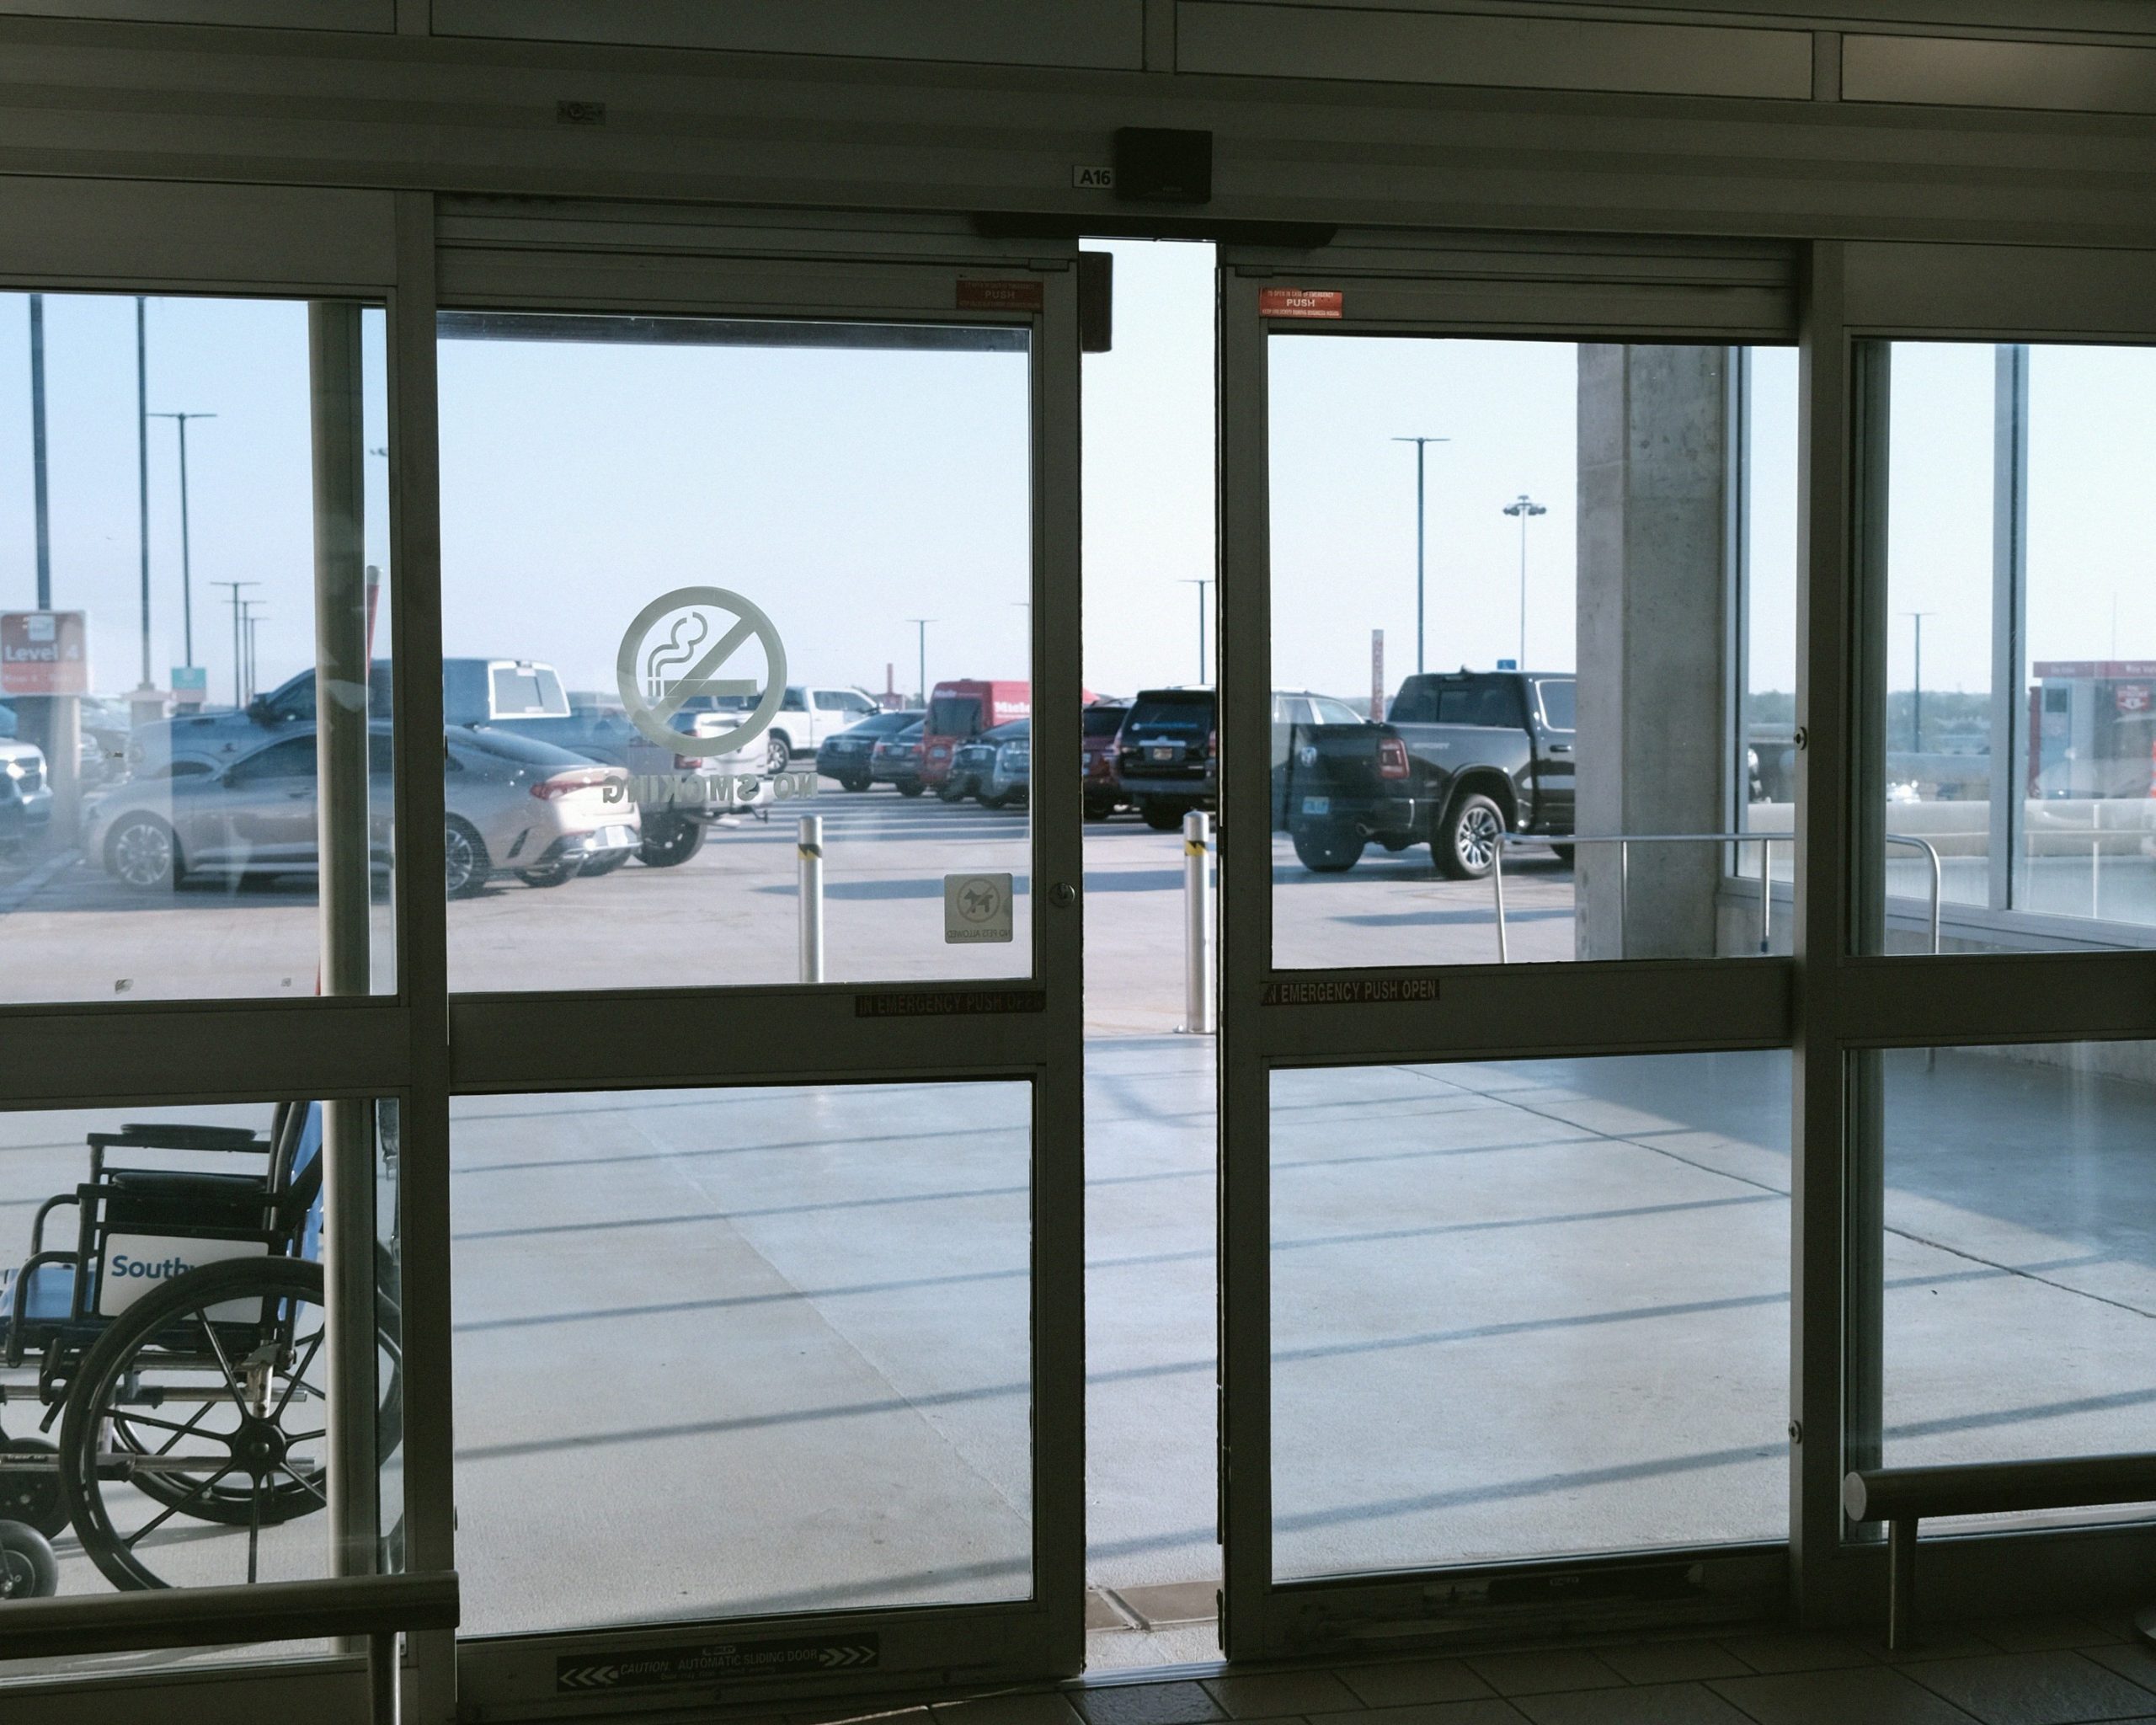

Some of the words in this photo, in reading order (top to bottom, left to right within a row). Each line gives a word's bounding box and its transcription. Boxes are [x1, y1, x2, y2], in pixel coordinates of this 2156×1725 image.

[1080, 169, 1111, 185] A16
[985, 290, 1016, 300] PUSH
[1286, 298, 1315, 307] PUSH
[6, 644, 59, 661] Level
[66, 644, 79, 661] 4
[1281, 982, 1360, 1003] EMERGENCY
[1364, 981, 1397, 1000] PUSH
[1402, 980, 1437, 998] OPEN
[877, 993, 960, 1012] EMERGENCY
[965, 992, 1003, 1012] PUSH
[677, 1655, 741, 1670] AUTOMATIC
[744, 1651, 784, 1665] SLIDING
[787, 1649, 818, 1662] DOOR
